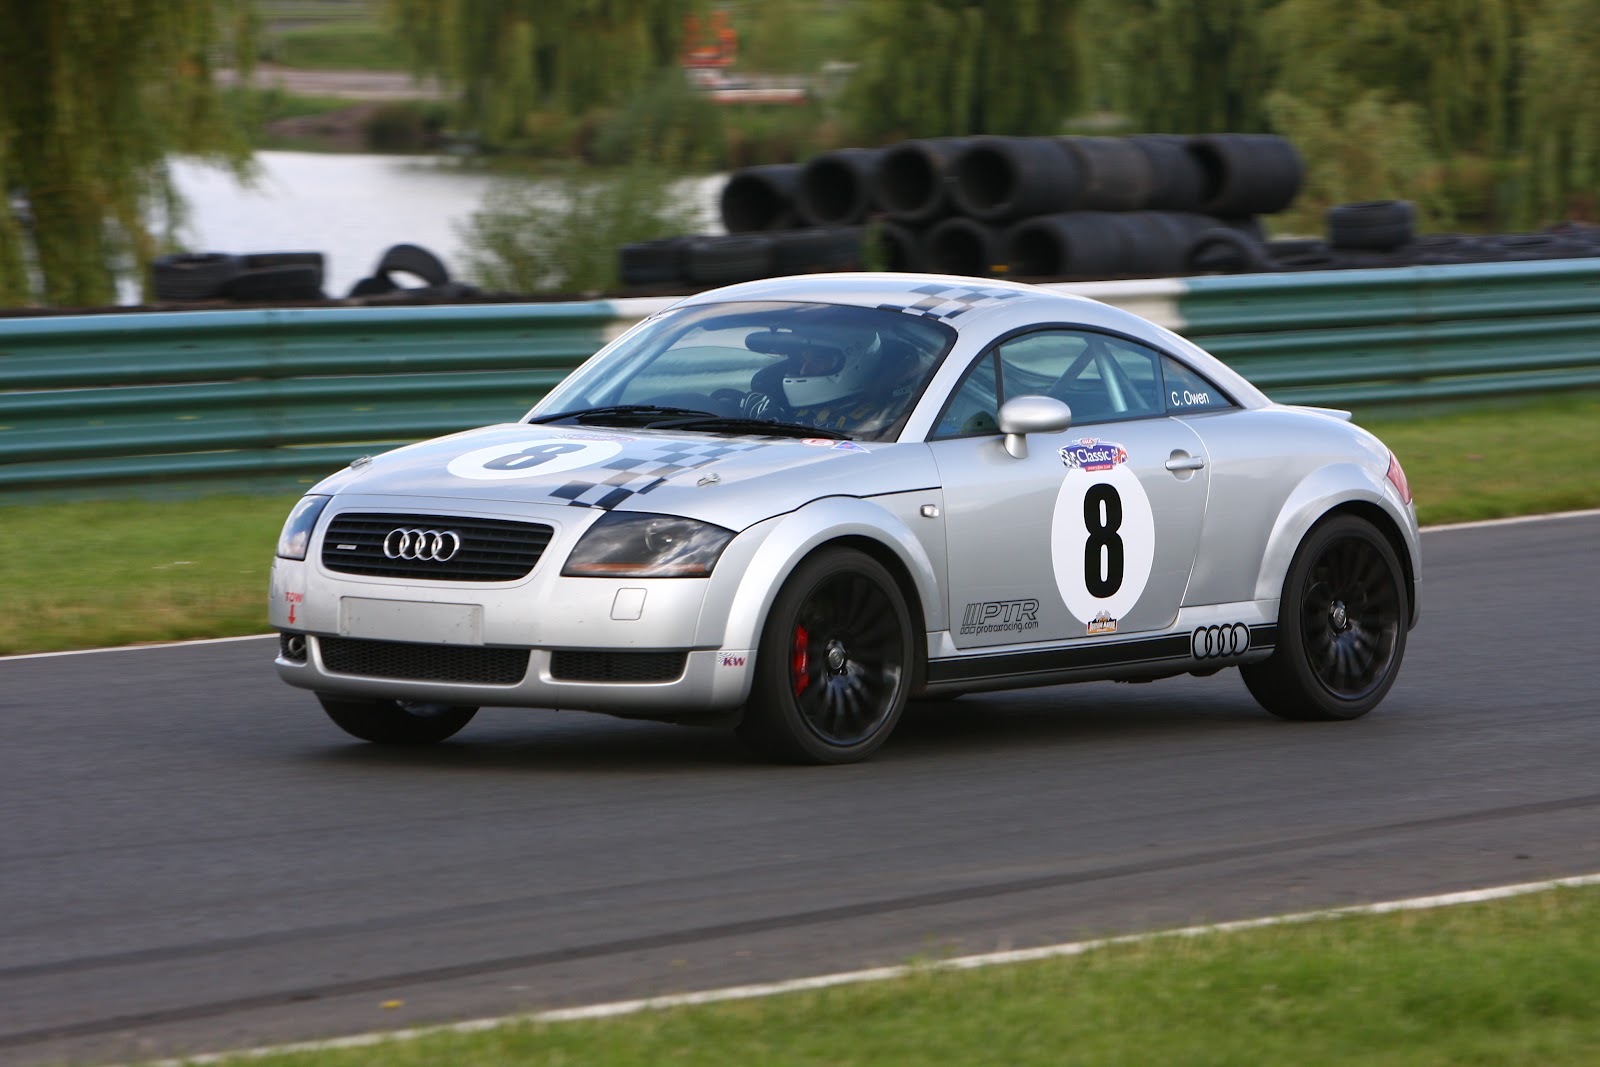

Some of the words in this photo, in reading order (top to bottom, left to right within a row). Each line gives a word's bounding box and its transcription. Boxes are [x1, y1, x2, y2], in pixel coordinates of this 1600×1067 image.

[1171, 391, 1183, 406] C.
[1183, 390, 1210, 405] Owen
[482, 443, 588, 471] 8
[1076, 448, 1112, 463] Classic
[1083, 483, 1124, 598] 8
[285, 591, 303, 603] TOW
[976, 620, 1039, 636] protraxracing.com
[723, 657, 746, 667] KW
